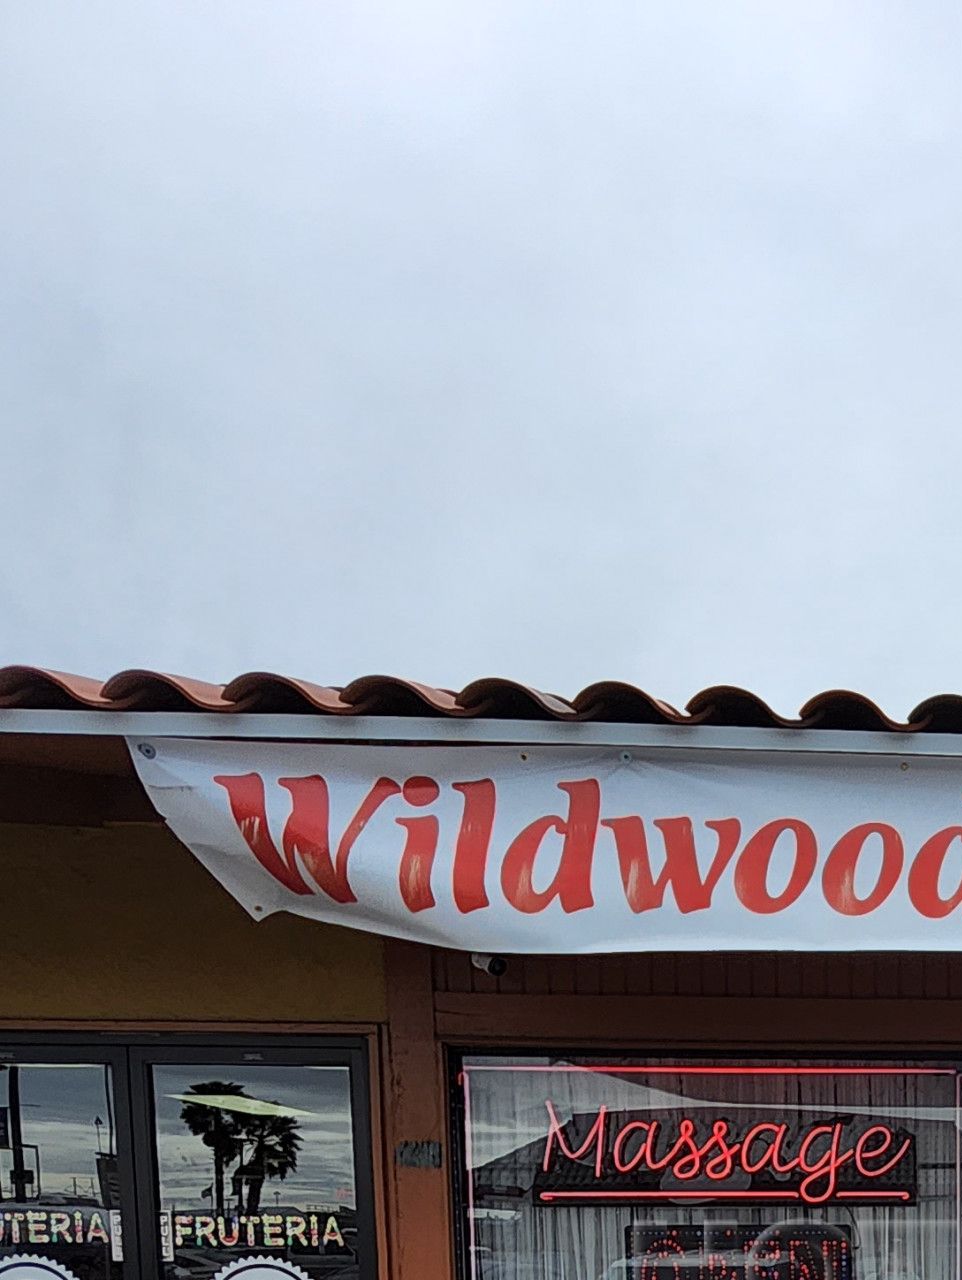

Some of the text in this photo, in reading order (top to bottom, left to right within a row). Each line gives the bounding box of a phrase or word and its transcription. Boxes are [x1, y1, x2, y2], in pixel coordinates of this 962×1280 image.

[541, 1099, 911, 1203] Massage
[0, 1211, 109, 1243] TERIA
[175, 1213, 345, 1247] FRUTERIA
